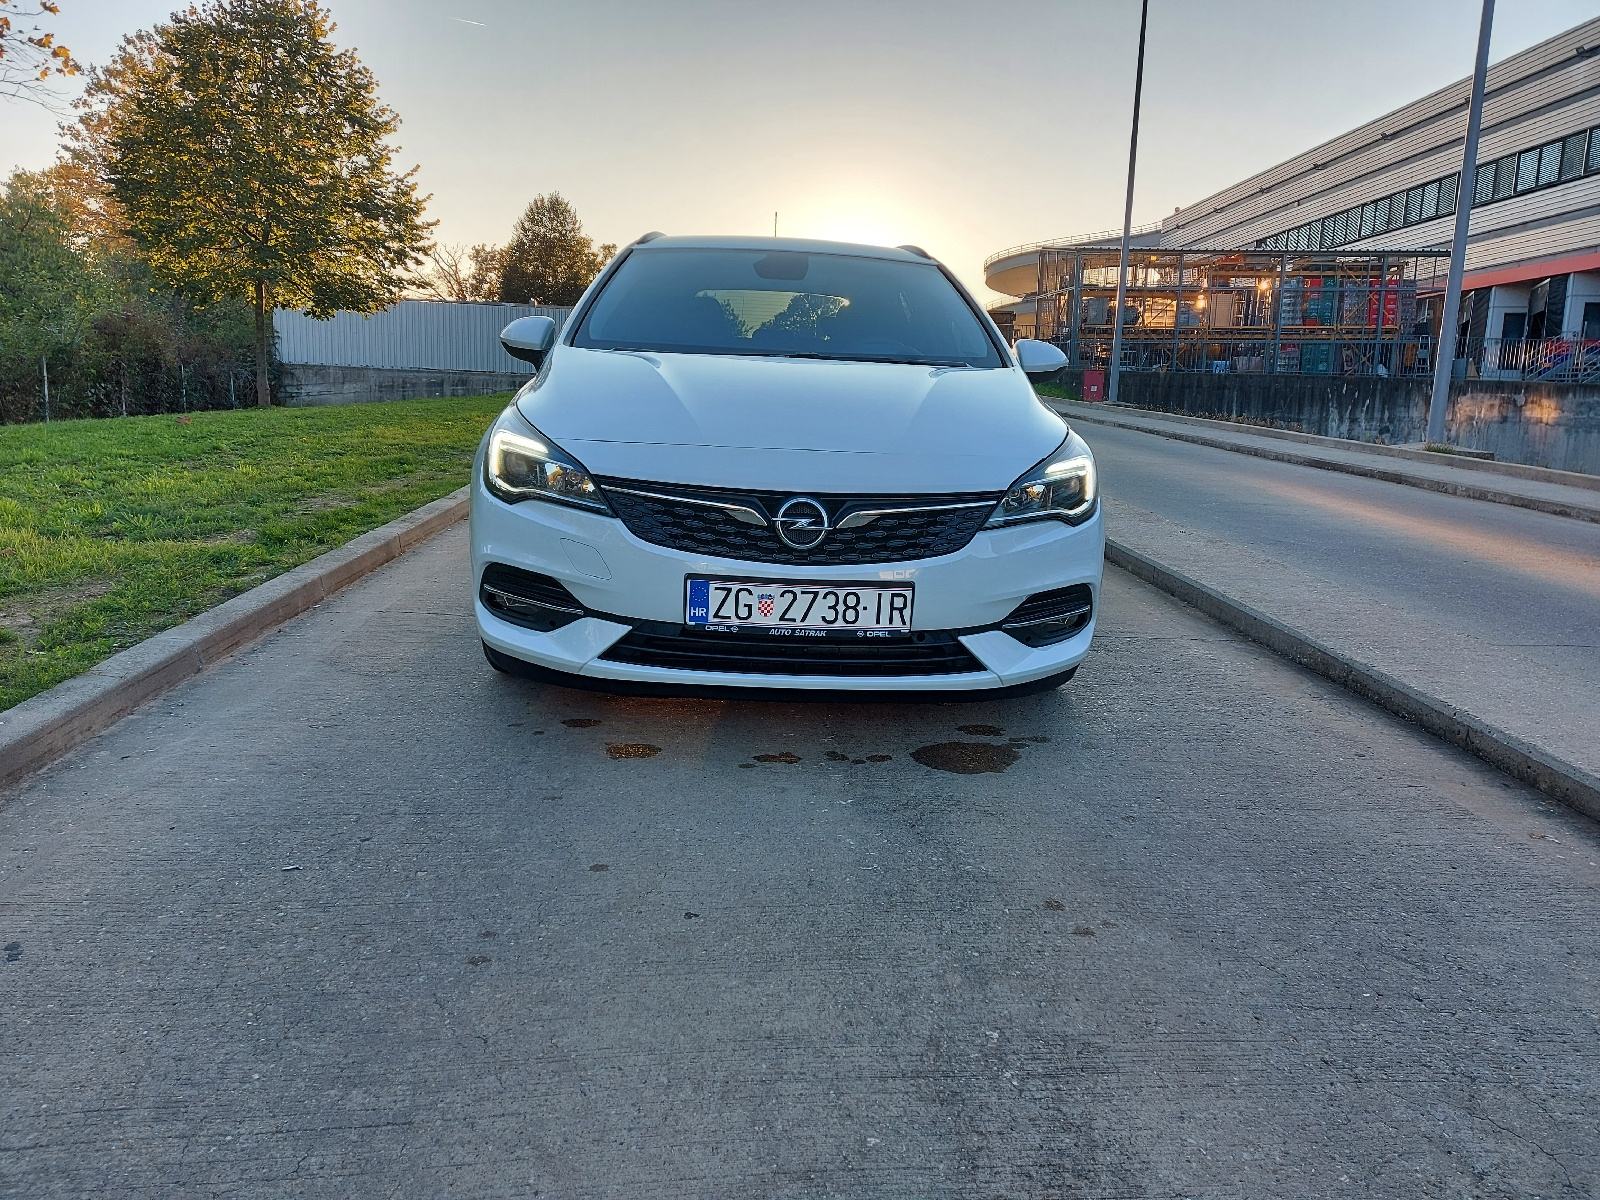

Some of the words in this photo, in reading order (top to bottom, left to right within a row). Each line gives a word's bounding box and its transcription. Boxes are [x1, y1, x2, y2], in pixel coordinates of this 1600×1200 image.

[713, 586, 754, 621] ZG
[690, 607, 707, 617] HR
[769, 628, 792, 636] AUTO
